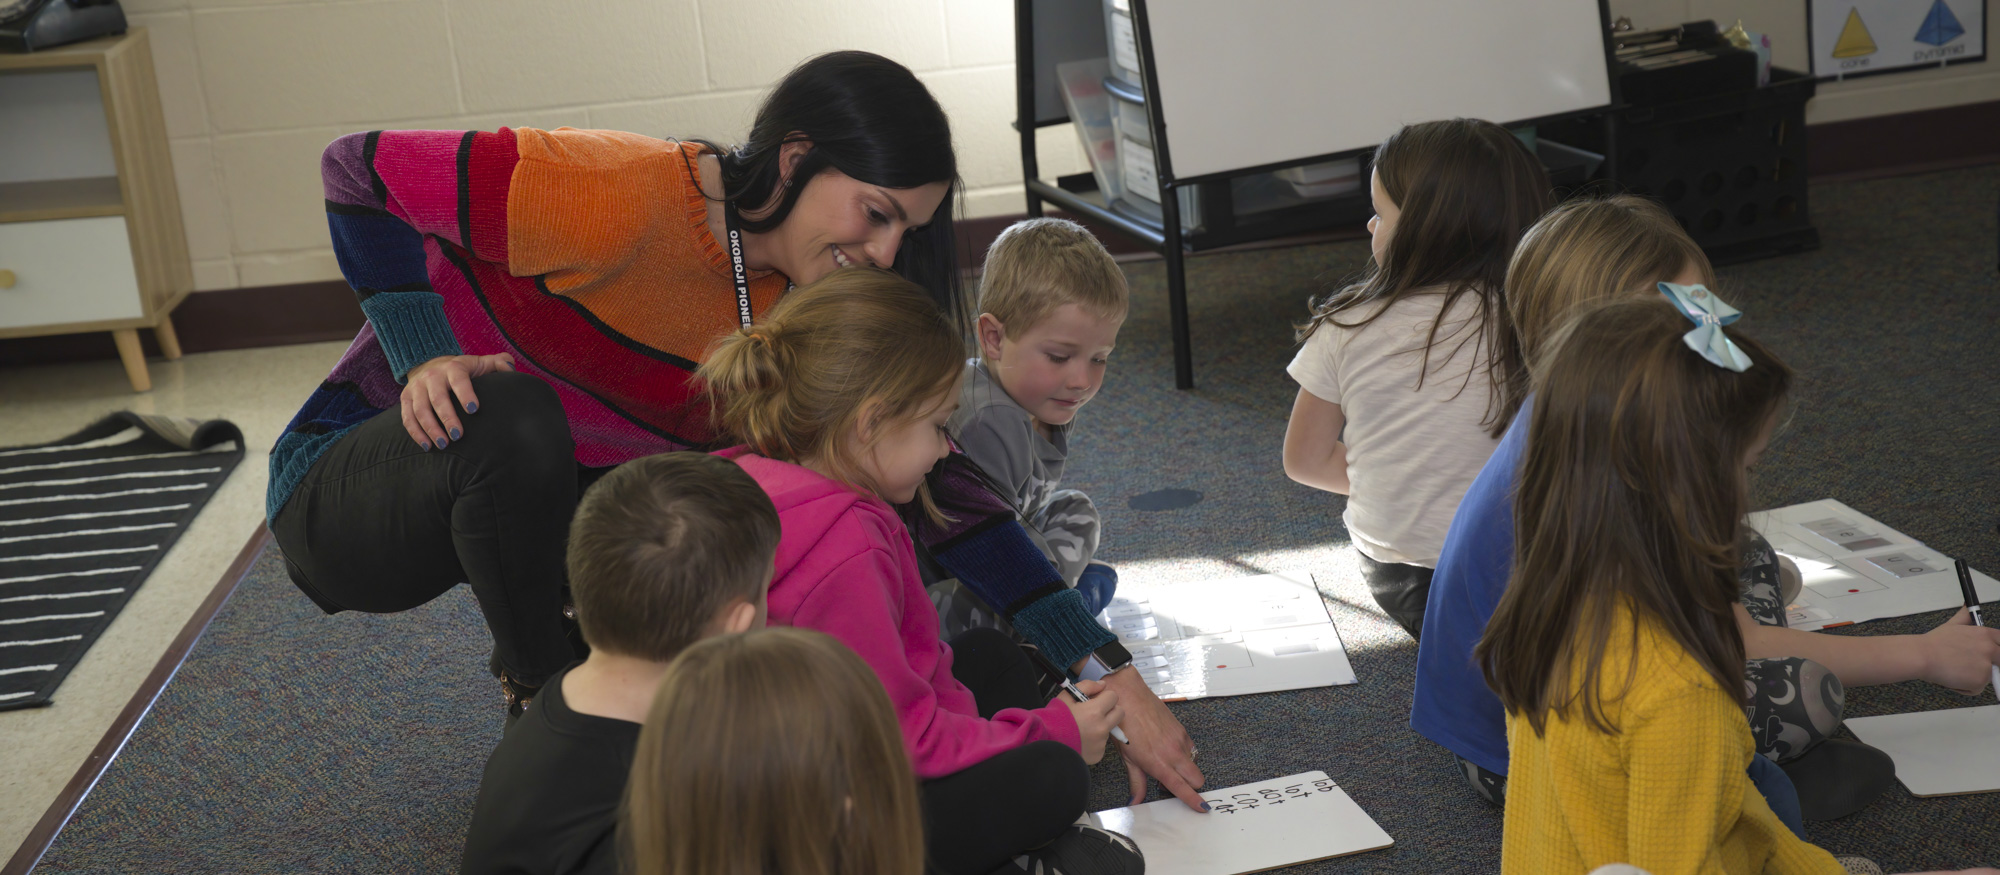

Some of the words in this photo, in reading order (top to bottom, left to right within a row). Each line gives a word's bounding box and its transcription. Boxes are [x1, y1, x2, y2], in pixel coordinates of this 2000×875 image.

[1913, 43, 1965, 62] pyramid
[1840, 57, 1870, 69] cone
[729, 230, 745, 284] OKOBOJI
[1285, 783, 1312, 799] lot
[1311, 777, 1339, 792] lob
[1231, 793, 1260, 810] cot
